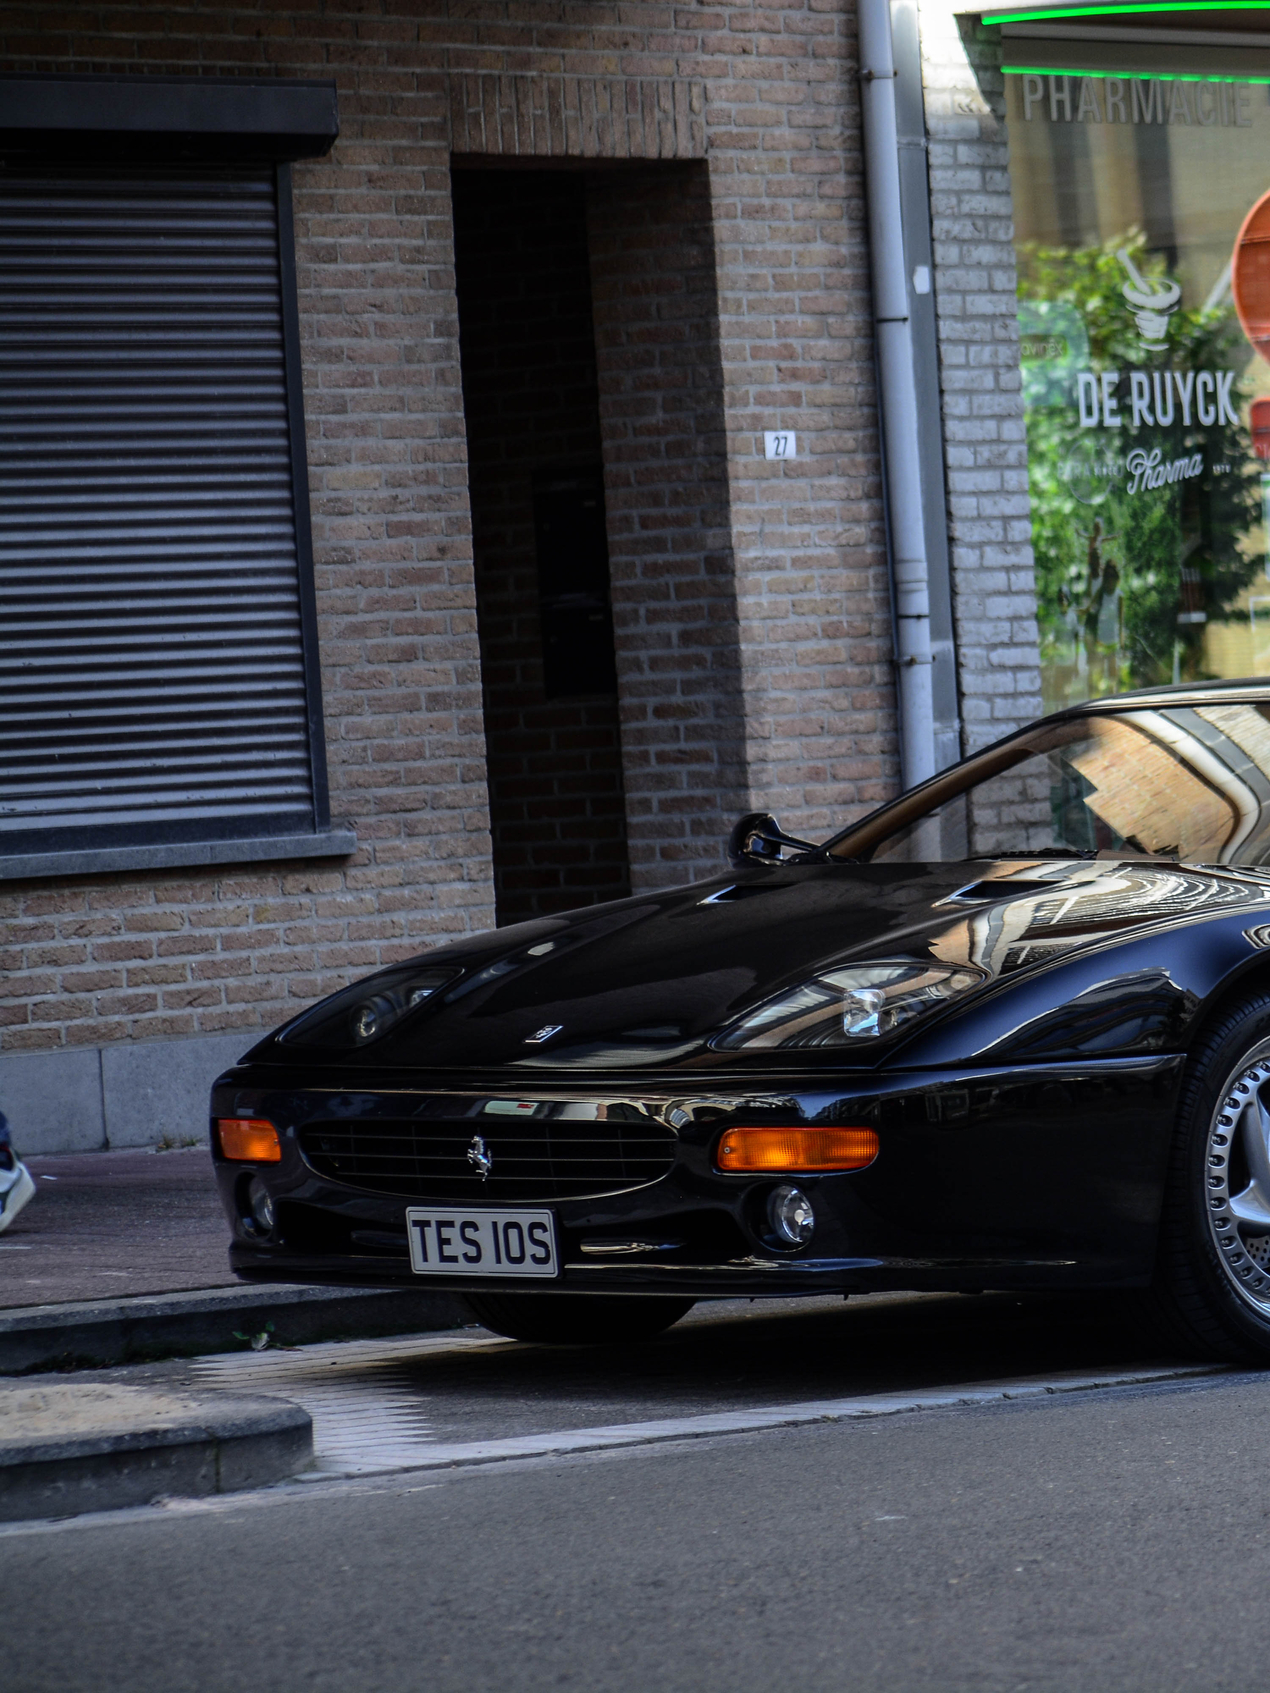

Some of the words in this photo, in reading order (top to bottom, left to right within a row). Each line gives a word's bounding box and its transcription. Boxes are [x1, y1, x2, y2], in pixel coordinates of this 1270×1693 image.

[1022, 75, 1252, 127] PHARMACIE
[1077, 371, 1122, 427] DE
[1131, 369, 1239, 427] RUYCK
[773, 436, 788, 456] 27
[1126, 447, 1203, 496] Pharma
[411, 1219, 482, 1264] TES
